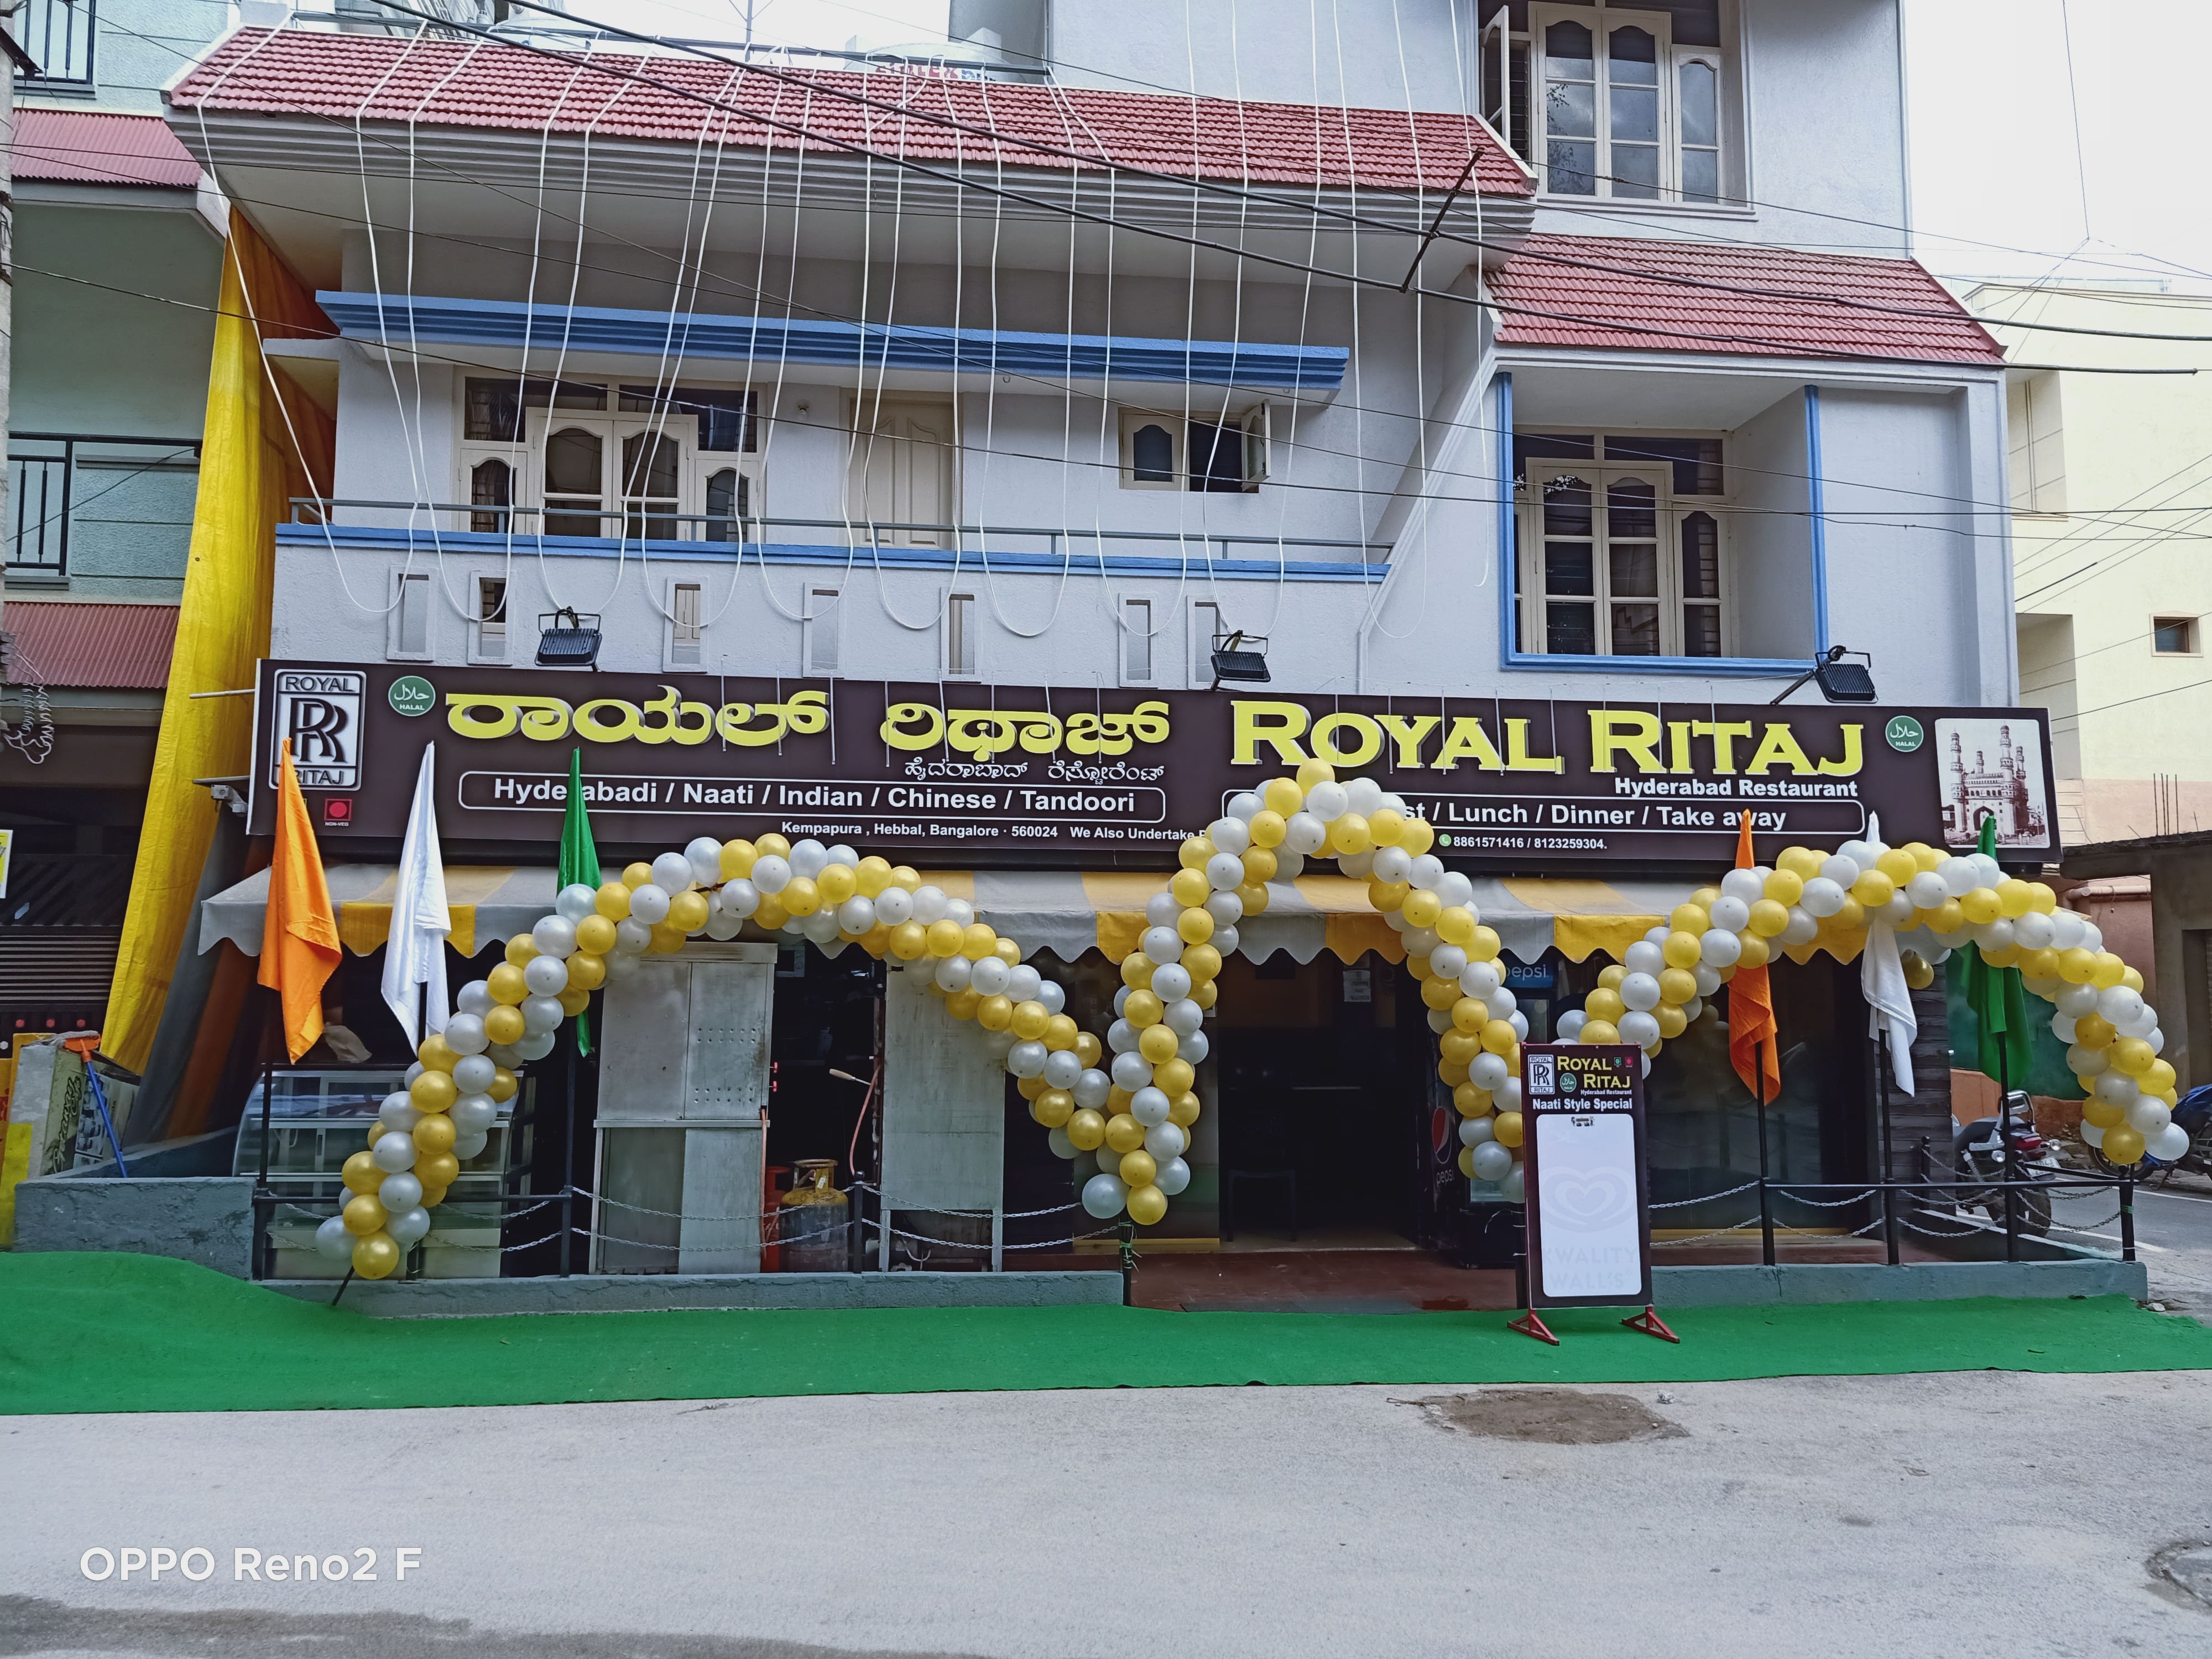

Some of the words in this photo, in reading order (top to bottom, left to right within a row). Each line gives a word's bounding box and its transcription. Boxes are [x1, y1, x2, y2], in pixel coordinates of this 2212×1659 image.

[285, 676, 355, 692] ROYAL
[394, 684, 430, 701] حلال
[445, 685, 831, 747] ರಾಯಲ್
[1230, 700, 1564, 774] ROYAL
[1587, 709, 1864, 777] RITAJ
[1890, 723, 1919, 739] حلال
[904, 756, 1028, 781] ಹೈದರಾಬಾದ್
[1048, 760, 1165, 785] ರೆಸ್ಟೋರೆಂಟ್
[494, 778, 656, 805] Hydeabadi
[665, 782, 675, 803] /
[683, 783, 753, 804] Naati
[761, 785, 771, 805] /
[779, 786, 862, 806] Indian
[871, 787, 880, 807] /
[888, 788, 996, 810] Chinese
[1004, 790, 1013, 810] /
[1020, 790, 1134, 812] Tandoori
[1614, 777, 1731, 797] Hyderabad
[1739, 779, 1858, 797] Restaurant
[1448, 802, 1527, 823] Lunch
[1536, 804, 1544, 823] /
[1551, 804, 1635, 825] Dinner
[1642, 806, 1649, 825] /
[1657, 806, 1715, 826] Take
[1723, 811, 1787, 831] away
[781, 822, 862, 836] Kempapura
[874, 823, 925, 837] Hebbal,
[930, 825, 999, 838] Bangalore
[1011, 826, 1058, 837] 560024
[1070, 827, 1091, 838] We
[1094, 827, 1124, 839] Also
[1128, 828, 1195, 841] Undertake
[1453, 836, 1524, 848] 8861571416
[1534, 838, 1607, 849] 8123259304.
[1557, 1056, 1612, 1071] ROYAL
[1583, 1073, 1631, 1088] RITAJ
[1532, 1098, 1561, 1109] Naati
[1564, 1098, 1590, 1112] Style
[1594, 1098, 1632, 1112] Special
[1437, 1165, 1454, 1187] pepsi
